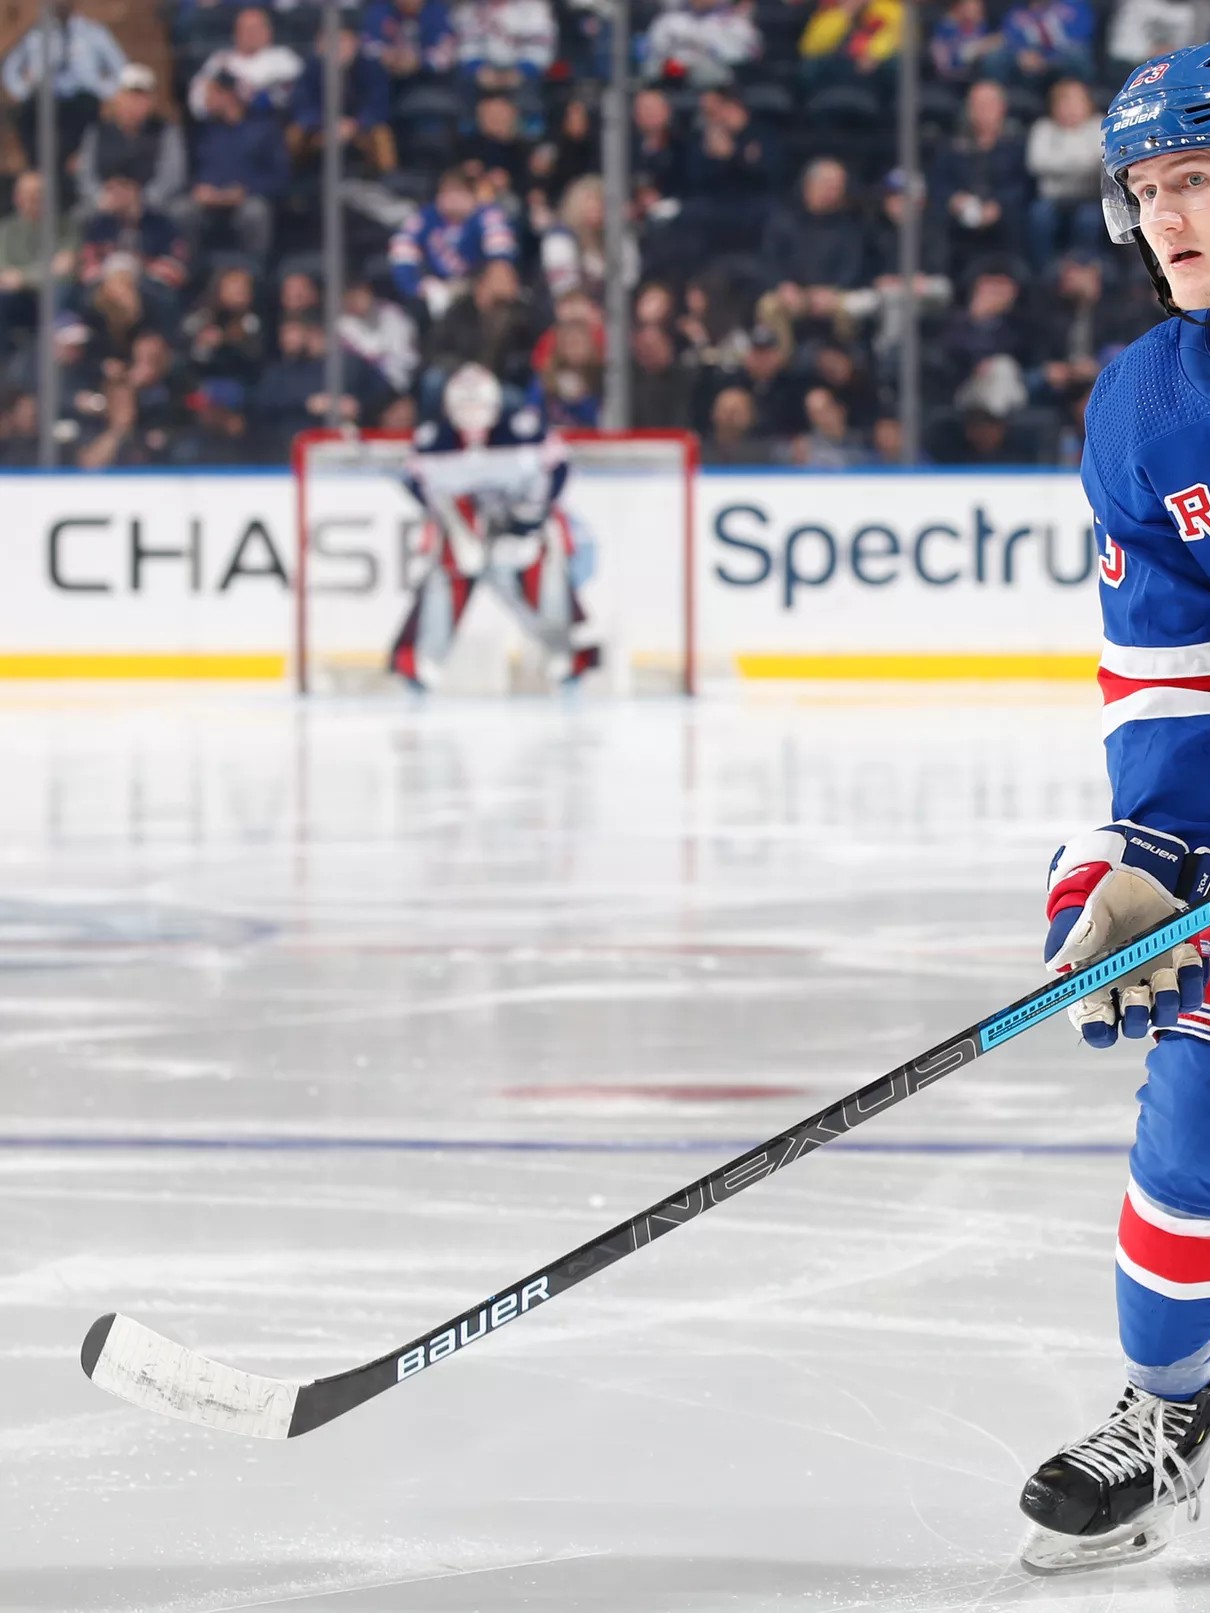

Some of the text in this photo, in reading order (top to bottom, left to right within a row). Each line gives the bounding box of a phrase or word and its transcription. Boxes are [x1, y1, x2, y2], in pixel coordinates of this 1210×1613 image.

[712, 503, 1095, 608] Spectru
[1129, 836, 1179, 863] BAUER
[631, 1038, 978, 1250] NEXUS
[397, 1275, 550, 1382] BAUER
